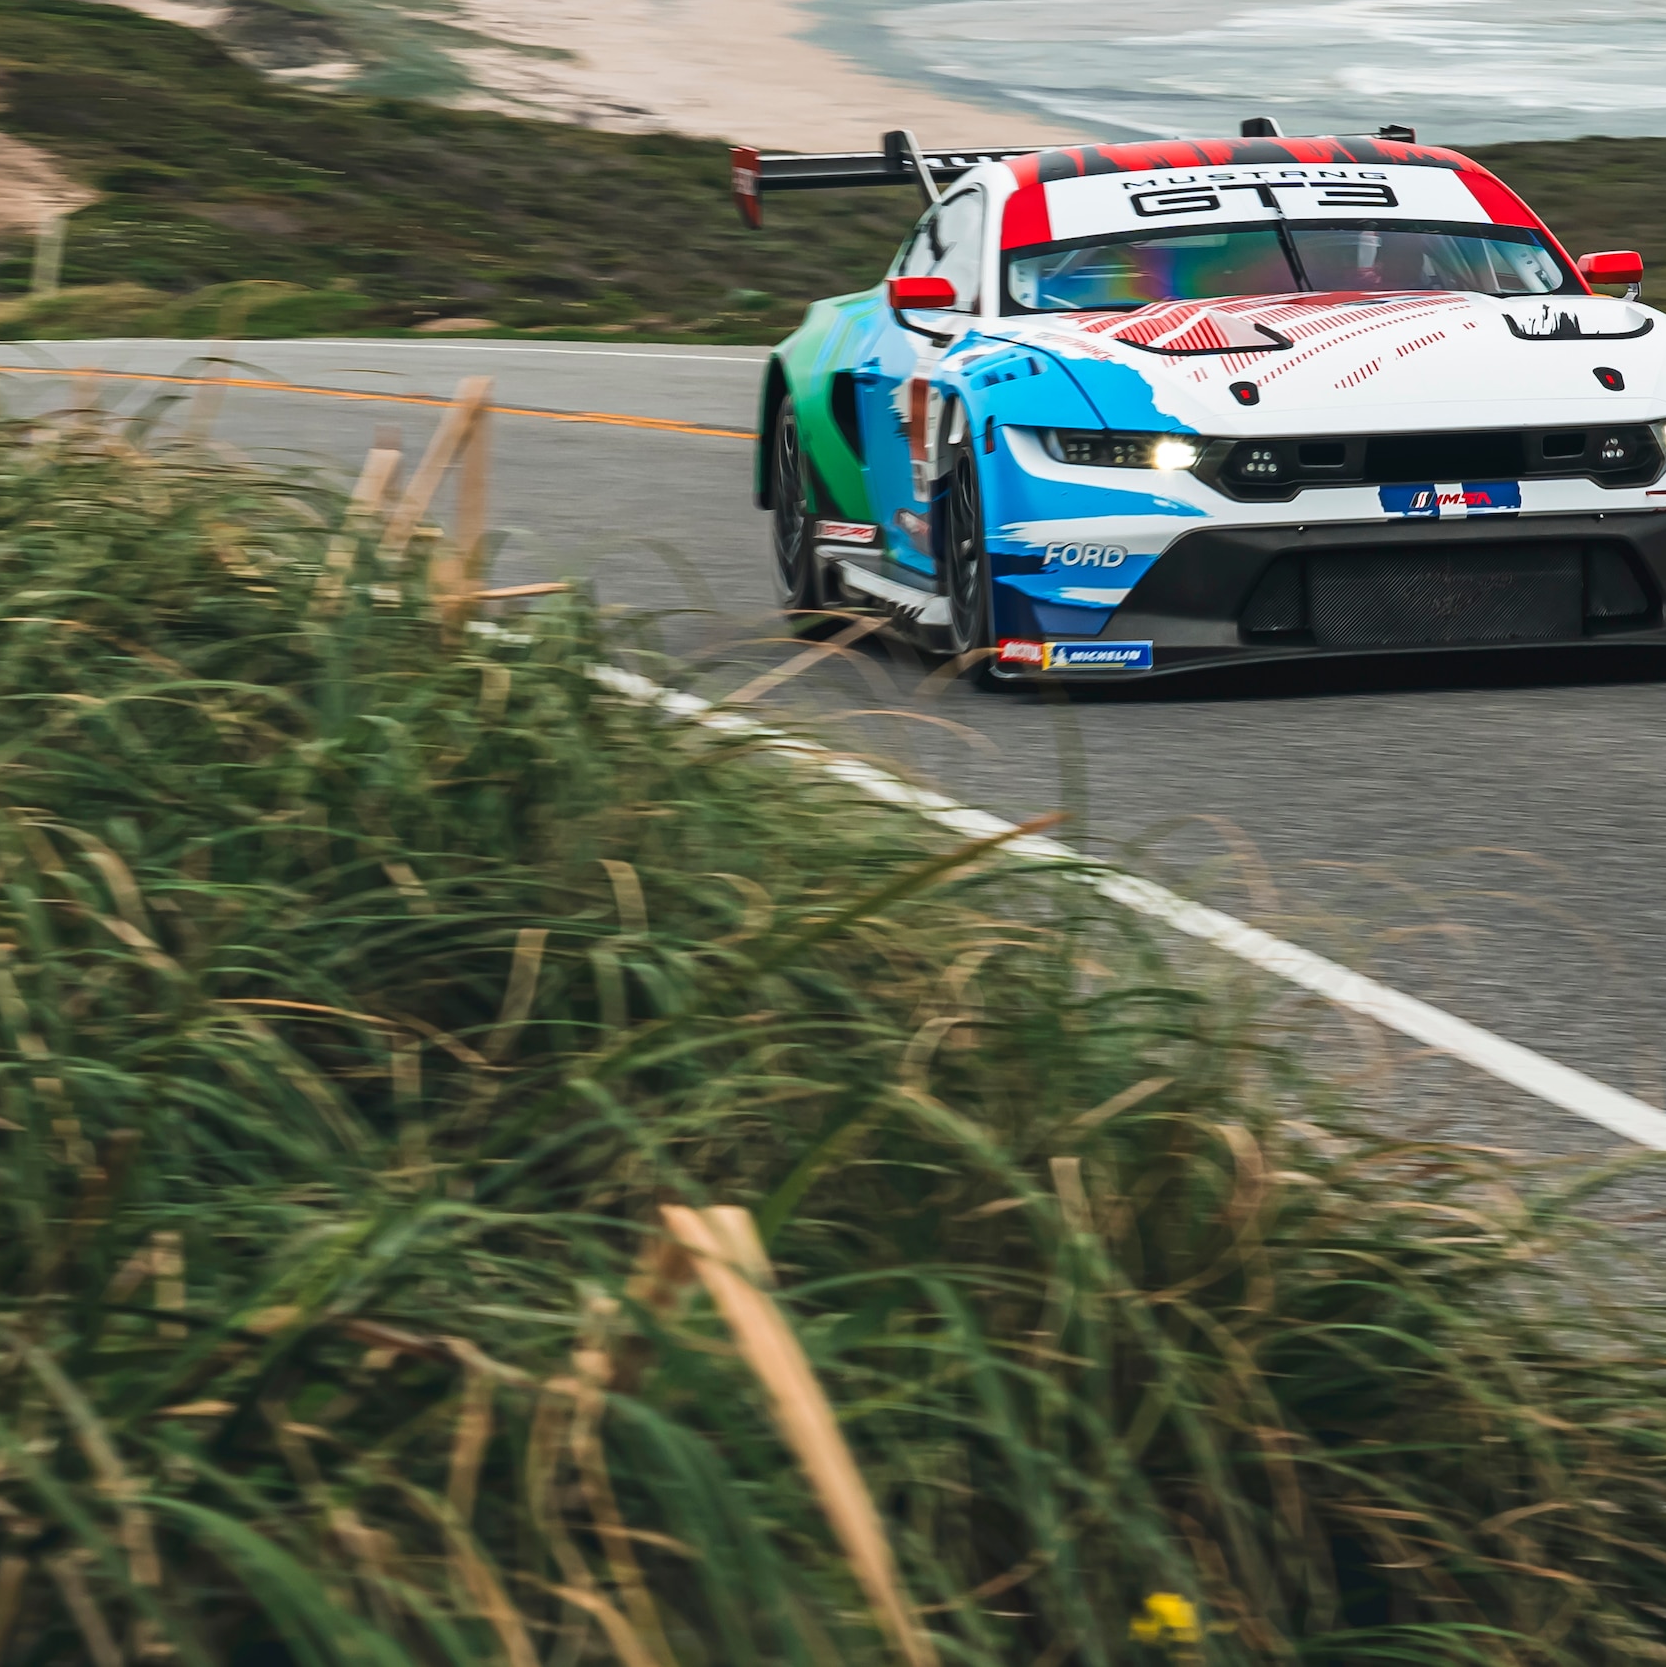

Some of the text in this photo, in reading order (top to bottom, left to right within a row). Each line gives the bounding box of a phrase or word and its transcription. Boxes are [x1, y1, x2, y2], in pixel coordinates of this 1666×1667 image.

[1120, 170, 1389, 190] MUSTANG
[1130, 181, 1399, 217] GT3
[1436, 492, 1491, 506] IMSA
[1042, 541, 1129, 568] FORD
[1068, 649, 1141, 663] MICHELIN
